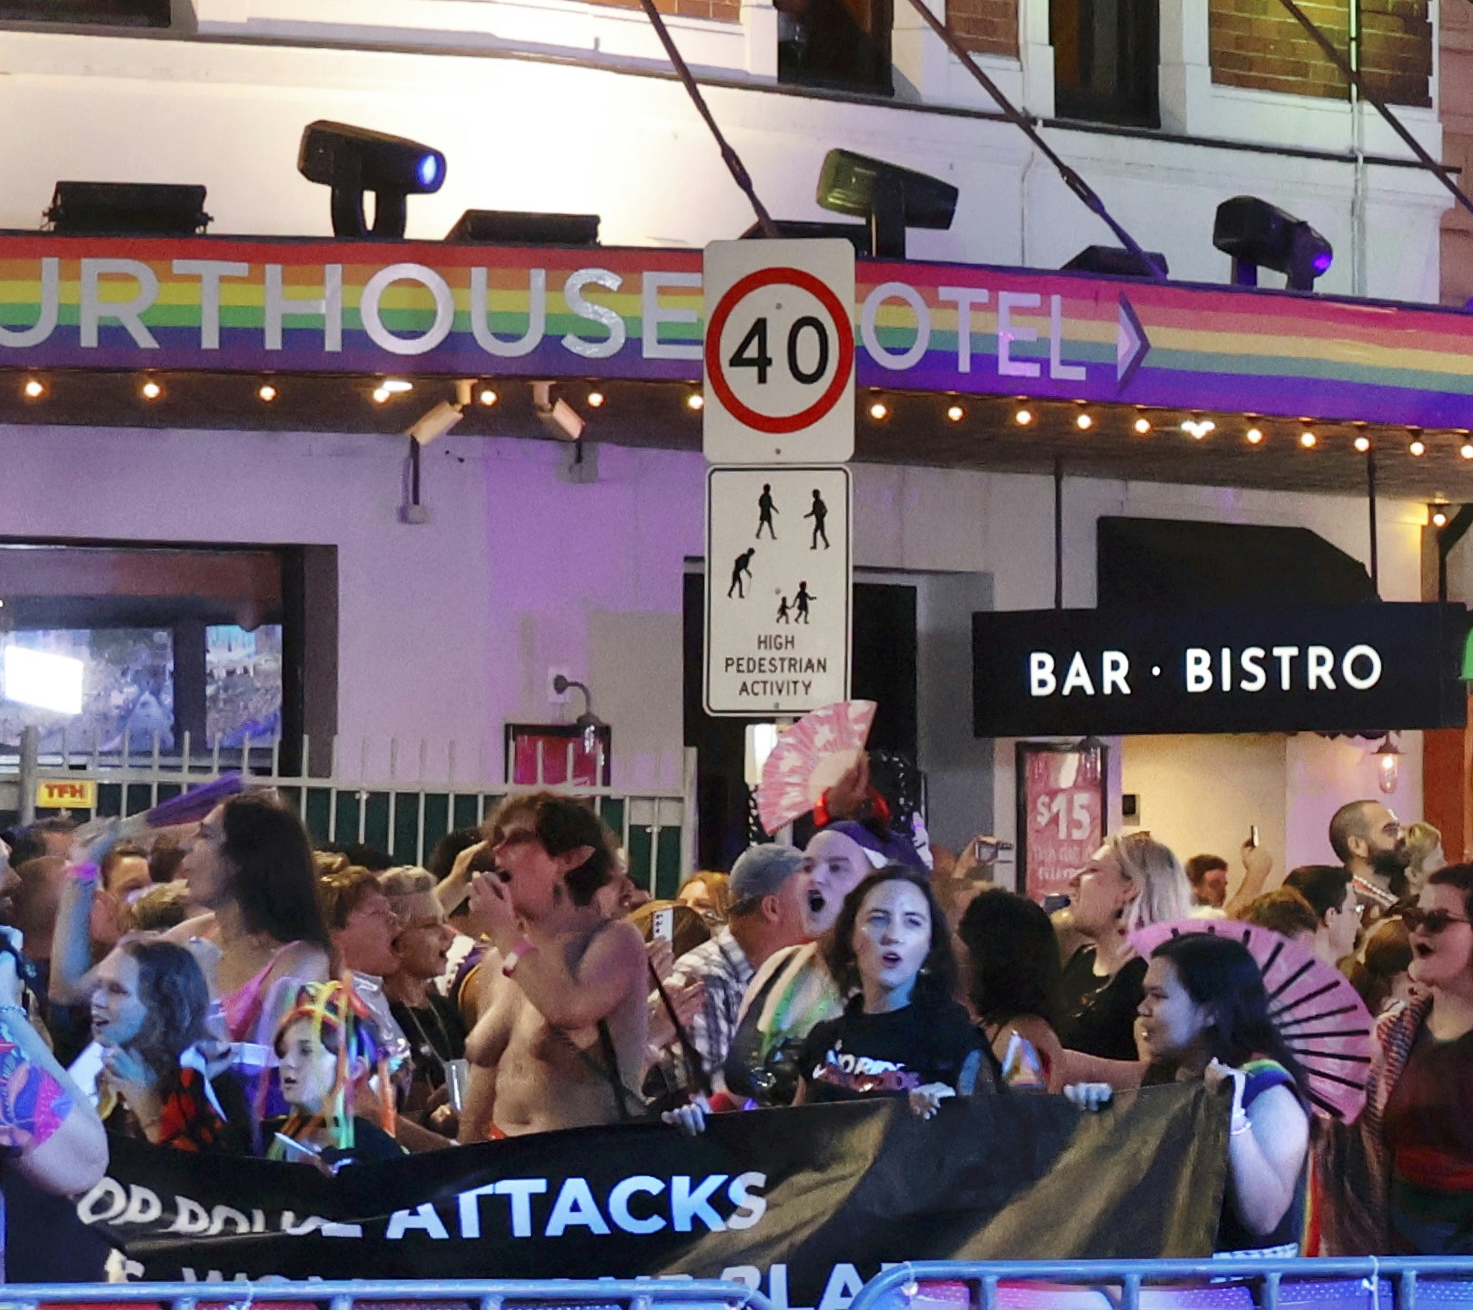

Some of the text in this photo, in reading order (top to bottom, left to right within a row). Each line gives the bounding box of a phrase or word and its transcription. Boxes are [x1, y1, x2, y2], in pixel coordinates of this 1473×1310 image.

[728, 315, 829, 386] 40
[860, 281, 1087, 382] OTEL
[724, 656, 828, 674] PEDESTRIAN
[756, 634, 796, 651] HIGH
[738, 679, 813, 697] ACTIVITY
[1028, 642, 1384, 698] BAR BISTRO
[1036, 792, 1093, 841] $15
[385, 1170, 768, 1240] ATTACKS
